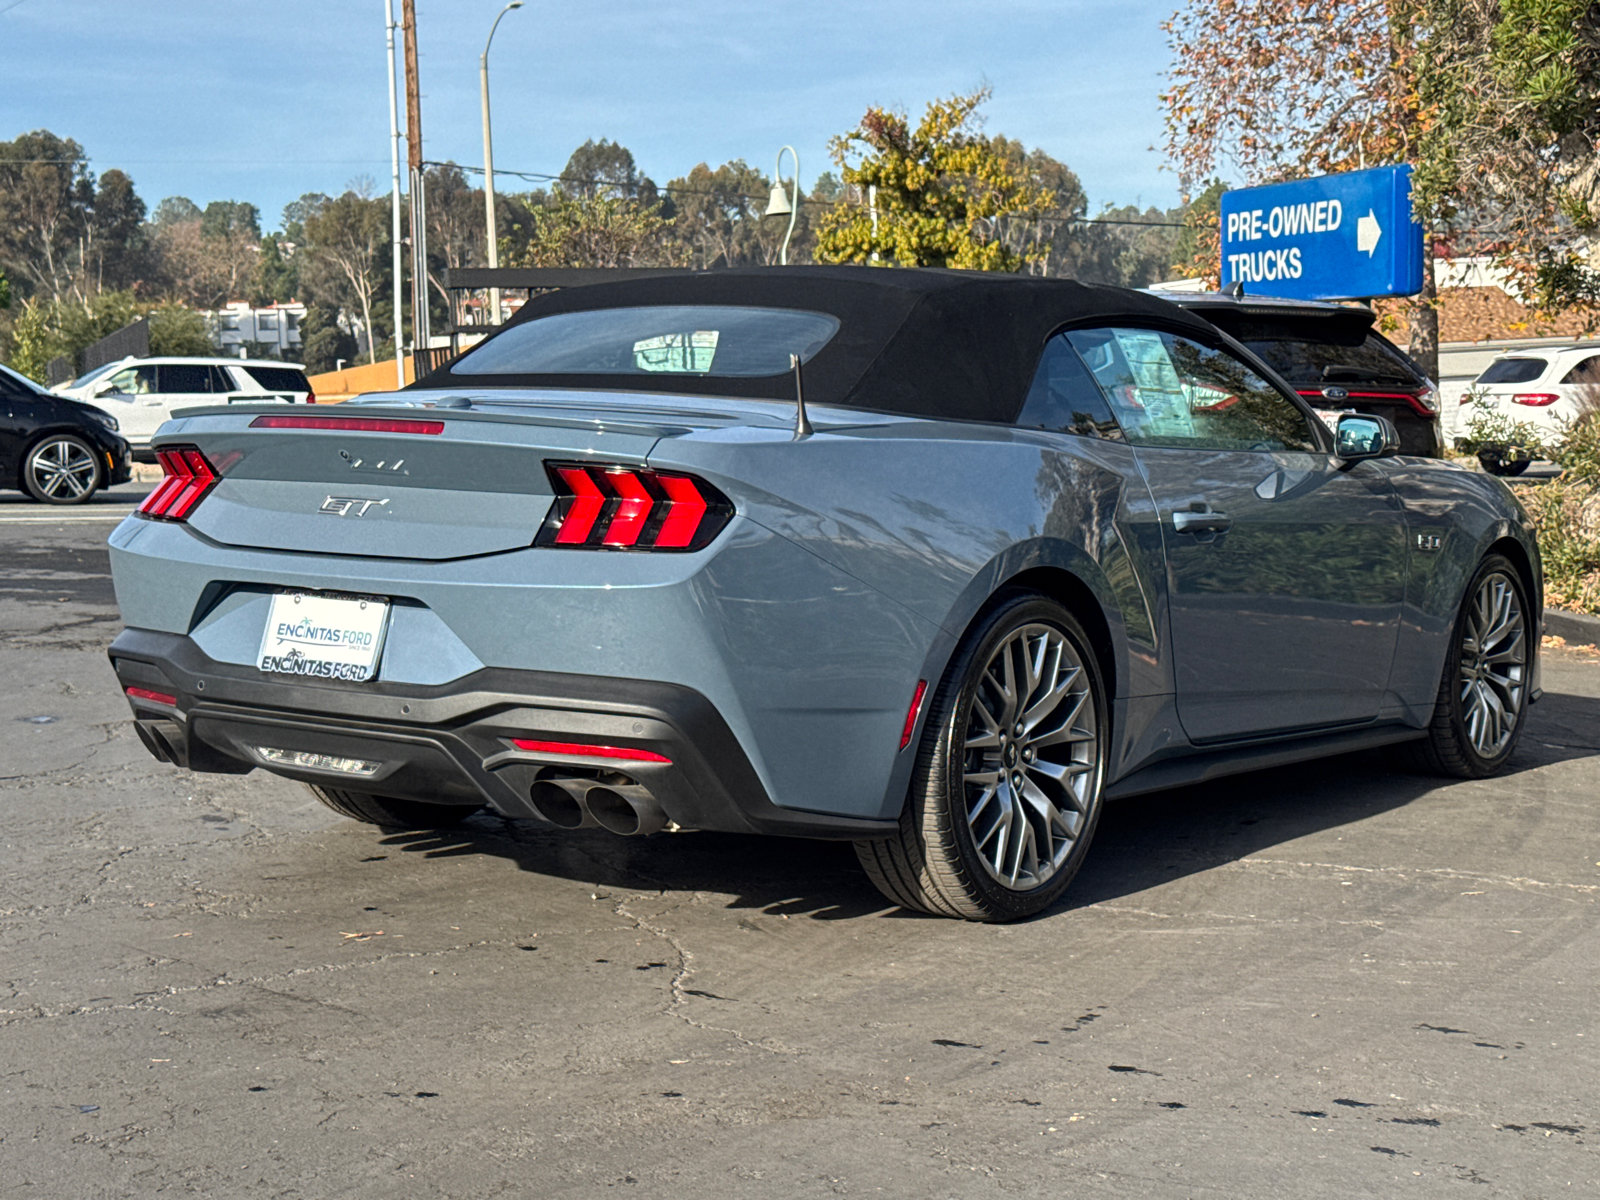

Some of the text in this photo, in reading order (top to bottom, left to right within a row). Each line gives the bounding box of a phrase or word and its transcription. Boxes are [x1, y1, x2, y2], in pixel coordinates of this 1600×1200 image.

[1227, 199, 1342, 243] PRE-OWNED
[1227, 247, 1302, 282] TRUCKS
[317, 495, 390, 517] GT
[276, 622, 372, 645] ENCINITAS FORD
[261, 655, 367, 680] ENCINITAS FORD
